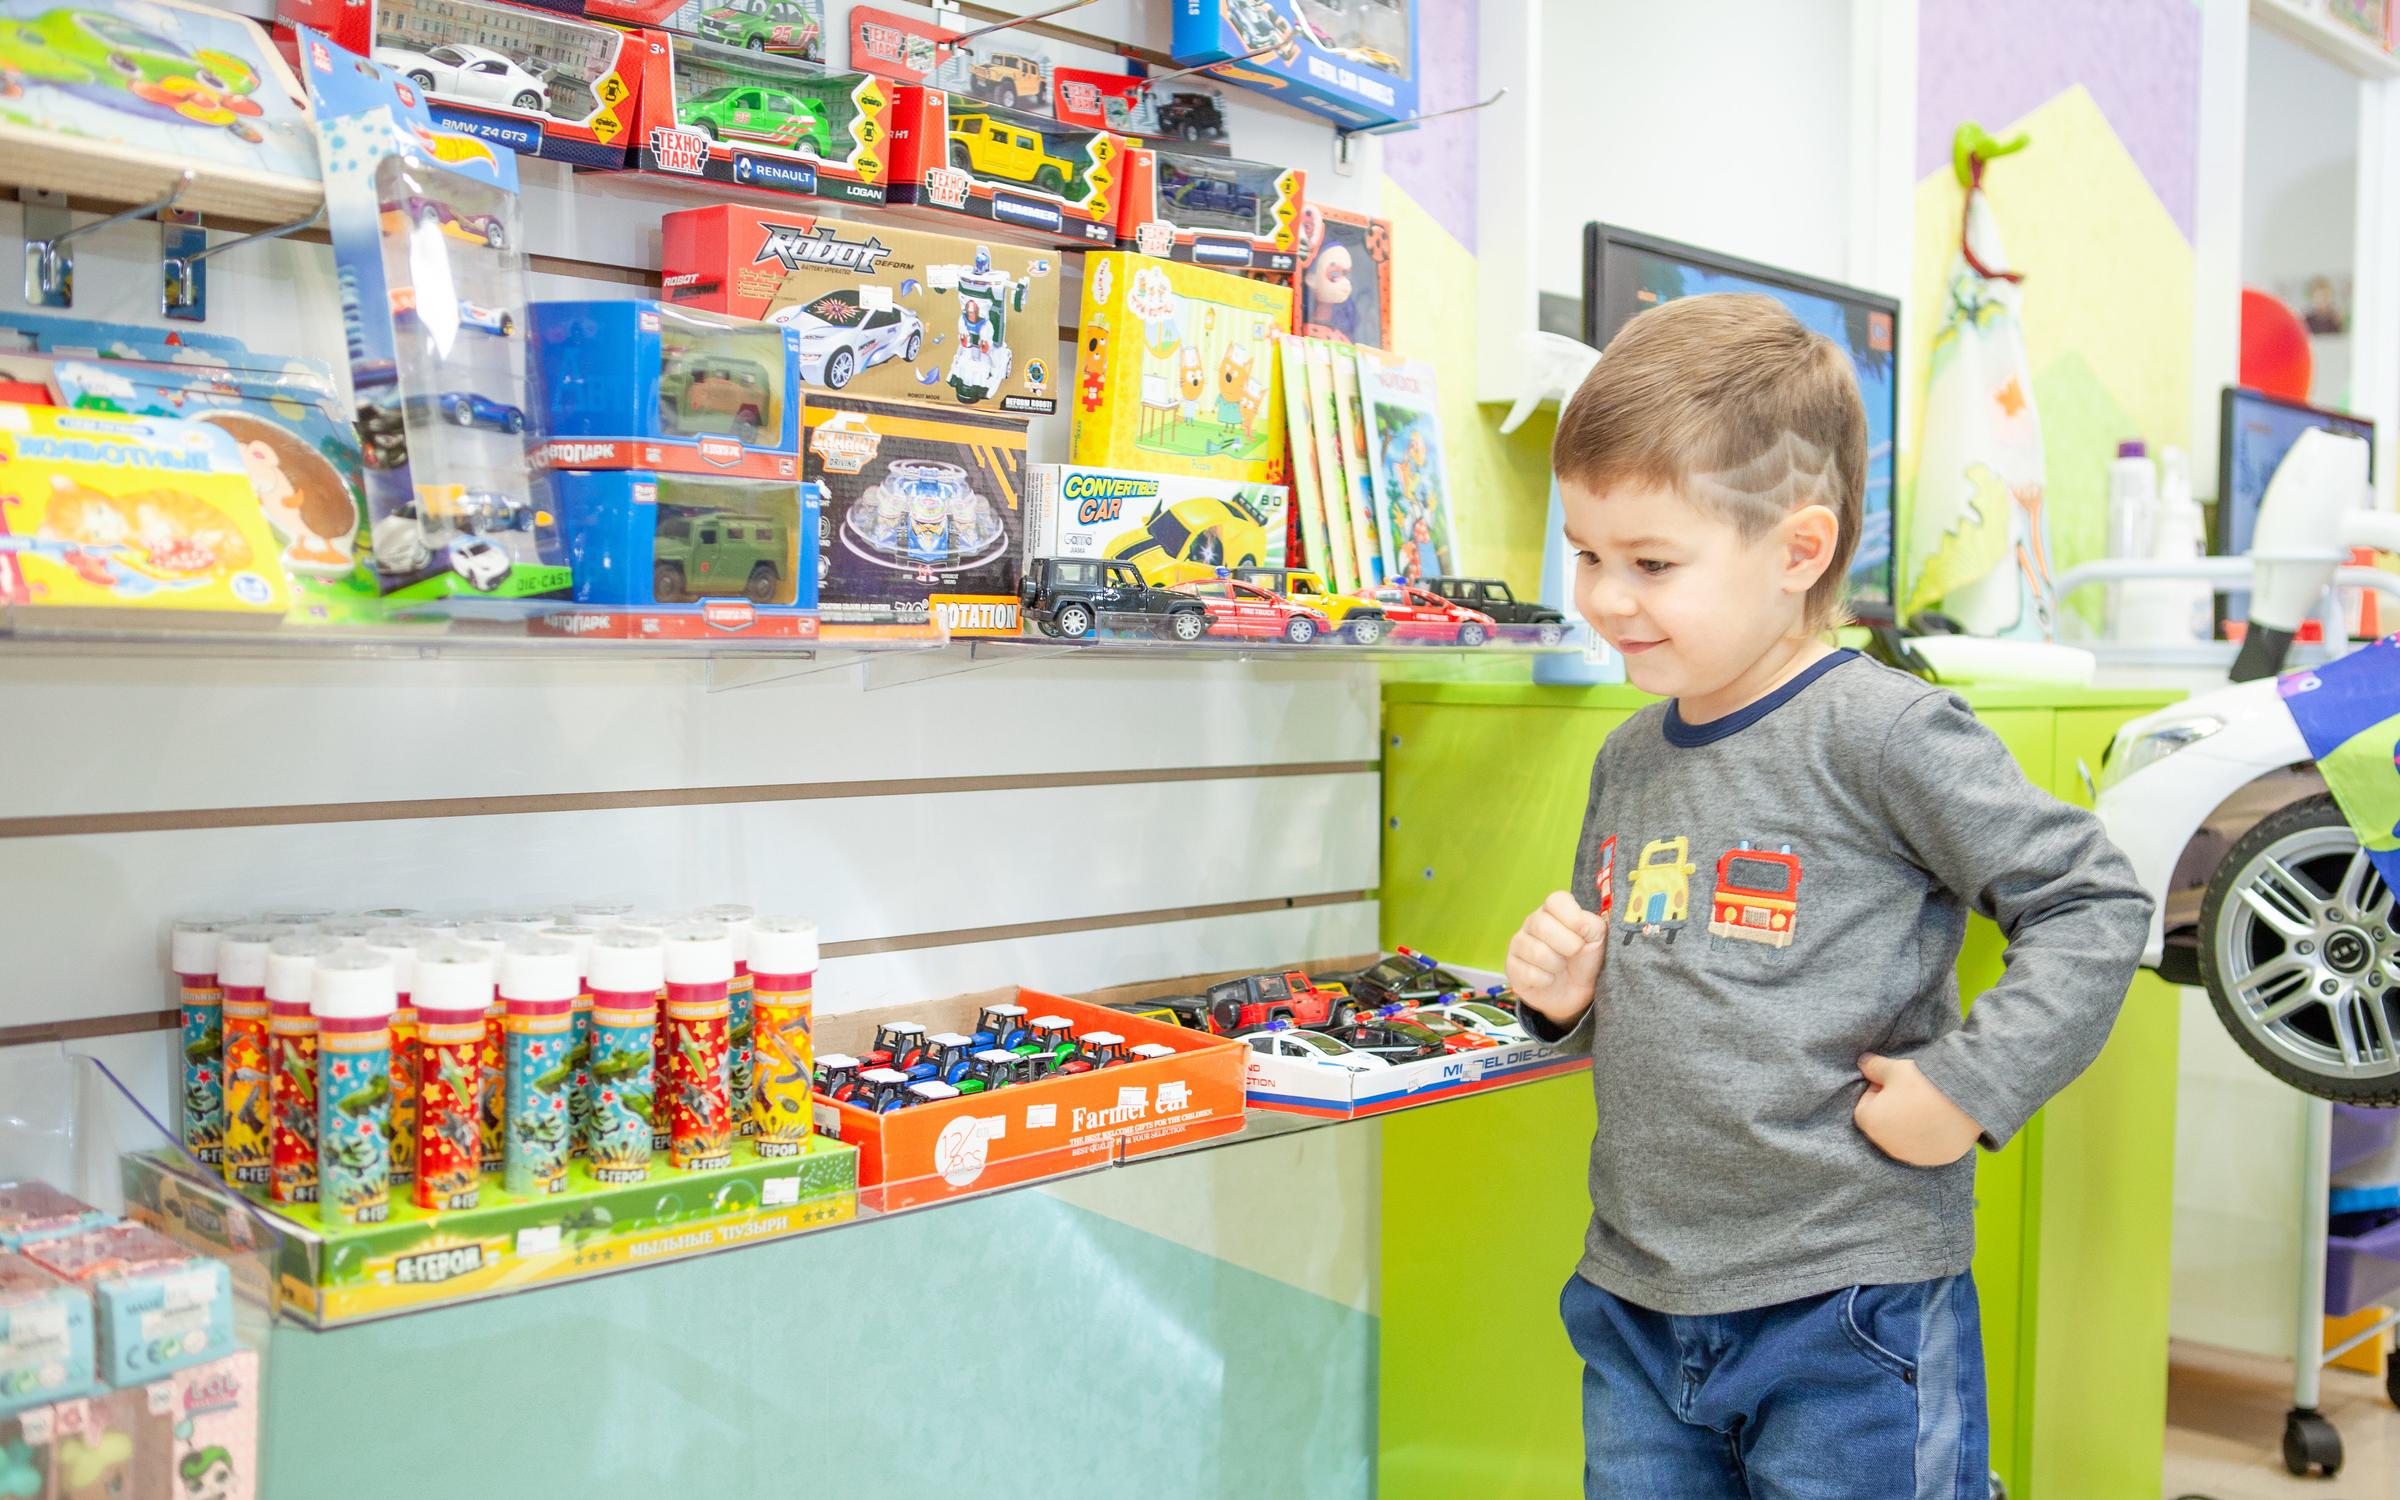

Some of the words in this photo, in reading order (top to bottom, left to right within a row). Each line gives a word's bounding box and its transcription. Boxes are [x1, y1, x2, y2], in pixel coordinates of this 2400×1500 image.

[772, 26, 793, 41] 25
[442, 118, 478, 134] BMW
[480, 124, 499, 138] Z4
[501, 129, 528, 143] GT3
[659, 131, 702, 154] ТЕХНО
[661, 150, 699, 171] ПАРК
[755, 164, 811, 183] RENAULT
[932, 172, 965, 191] ТЕХНО
[847, 185, 882, 200] LOGAN
[932, 187, 964, 204] ПАРК
[996, 200, 1060, 223] HUMMER
[801, 264, 824, 273] BATTERY
[824, 267, 852, 276] OPERATED
[875, 259, 915, 271] DEFORM
[664, 273, 700, 287] ROBOT
[829, 457, 857, 468] DRIVING
[1064, 474, 1160, 499] CONVERTIBLE
[1078, 498, 1122, 524] CAR
[936, 602, 1018, 629] ROTATION
[1240, 607, 1255, 615] FIRE
[1255, 608, 1276, 616] TRUCK
[1507, 1046, 1556, 1064] DIE-C
[1443, 1057, 1504, 1078] MEL
[1246, 1076, 1276, 1088] CTION
[1069, 1136, 1085, 1148] THE
[1085, 1132, 1102, 1145] BEST
[1102, 1125, 1135, 1140] WELCOME
[1135, 1121, 1154, 1133] GIFTS
[1154, 1118, 1168, 1128] FOR
[1167, 1115, 1181, 1125] THE
[1072, 1145, 1089, 1157] BEST
[1132, 1132, 1151, 1143] YOUR
[237, 1166, 271, 1182] Я-ГЕР
[629, 1229, 714, 1258] МЫЛЬНЫЕ
